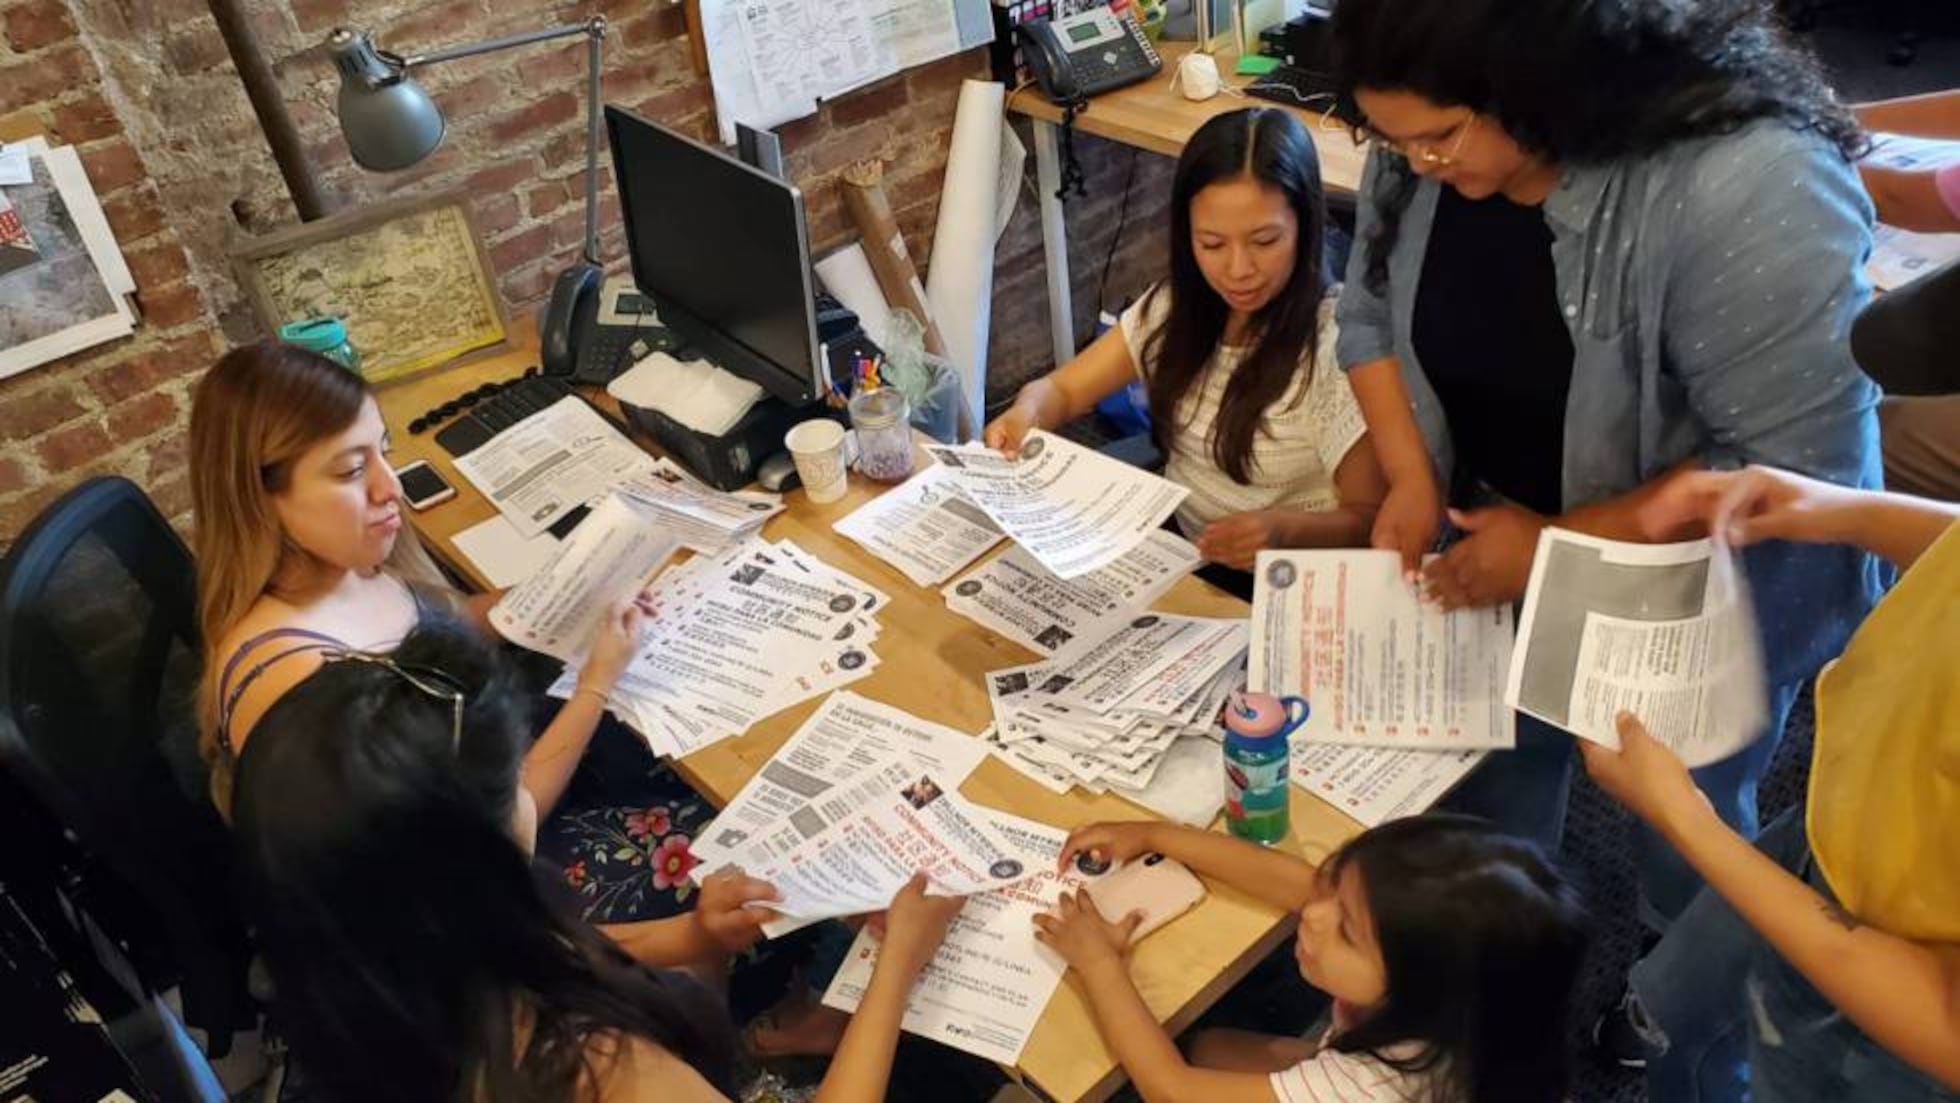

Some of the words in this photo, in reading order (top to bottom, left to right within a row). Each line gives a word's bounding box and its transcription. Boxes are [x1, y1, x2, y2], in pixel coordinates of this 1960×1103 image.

[729, 584, 792, 610] COMMUNITY
[793, 604, 832, 622] NOTICE
[891, 802, 953, 856] COMMUNITY
[950, 856, 986, 885] NOTICE
